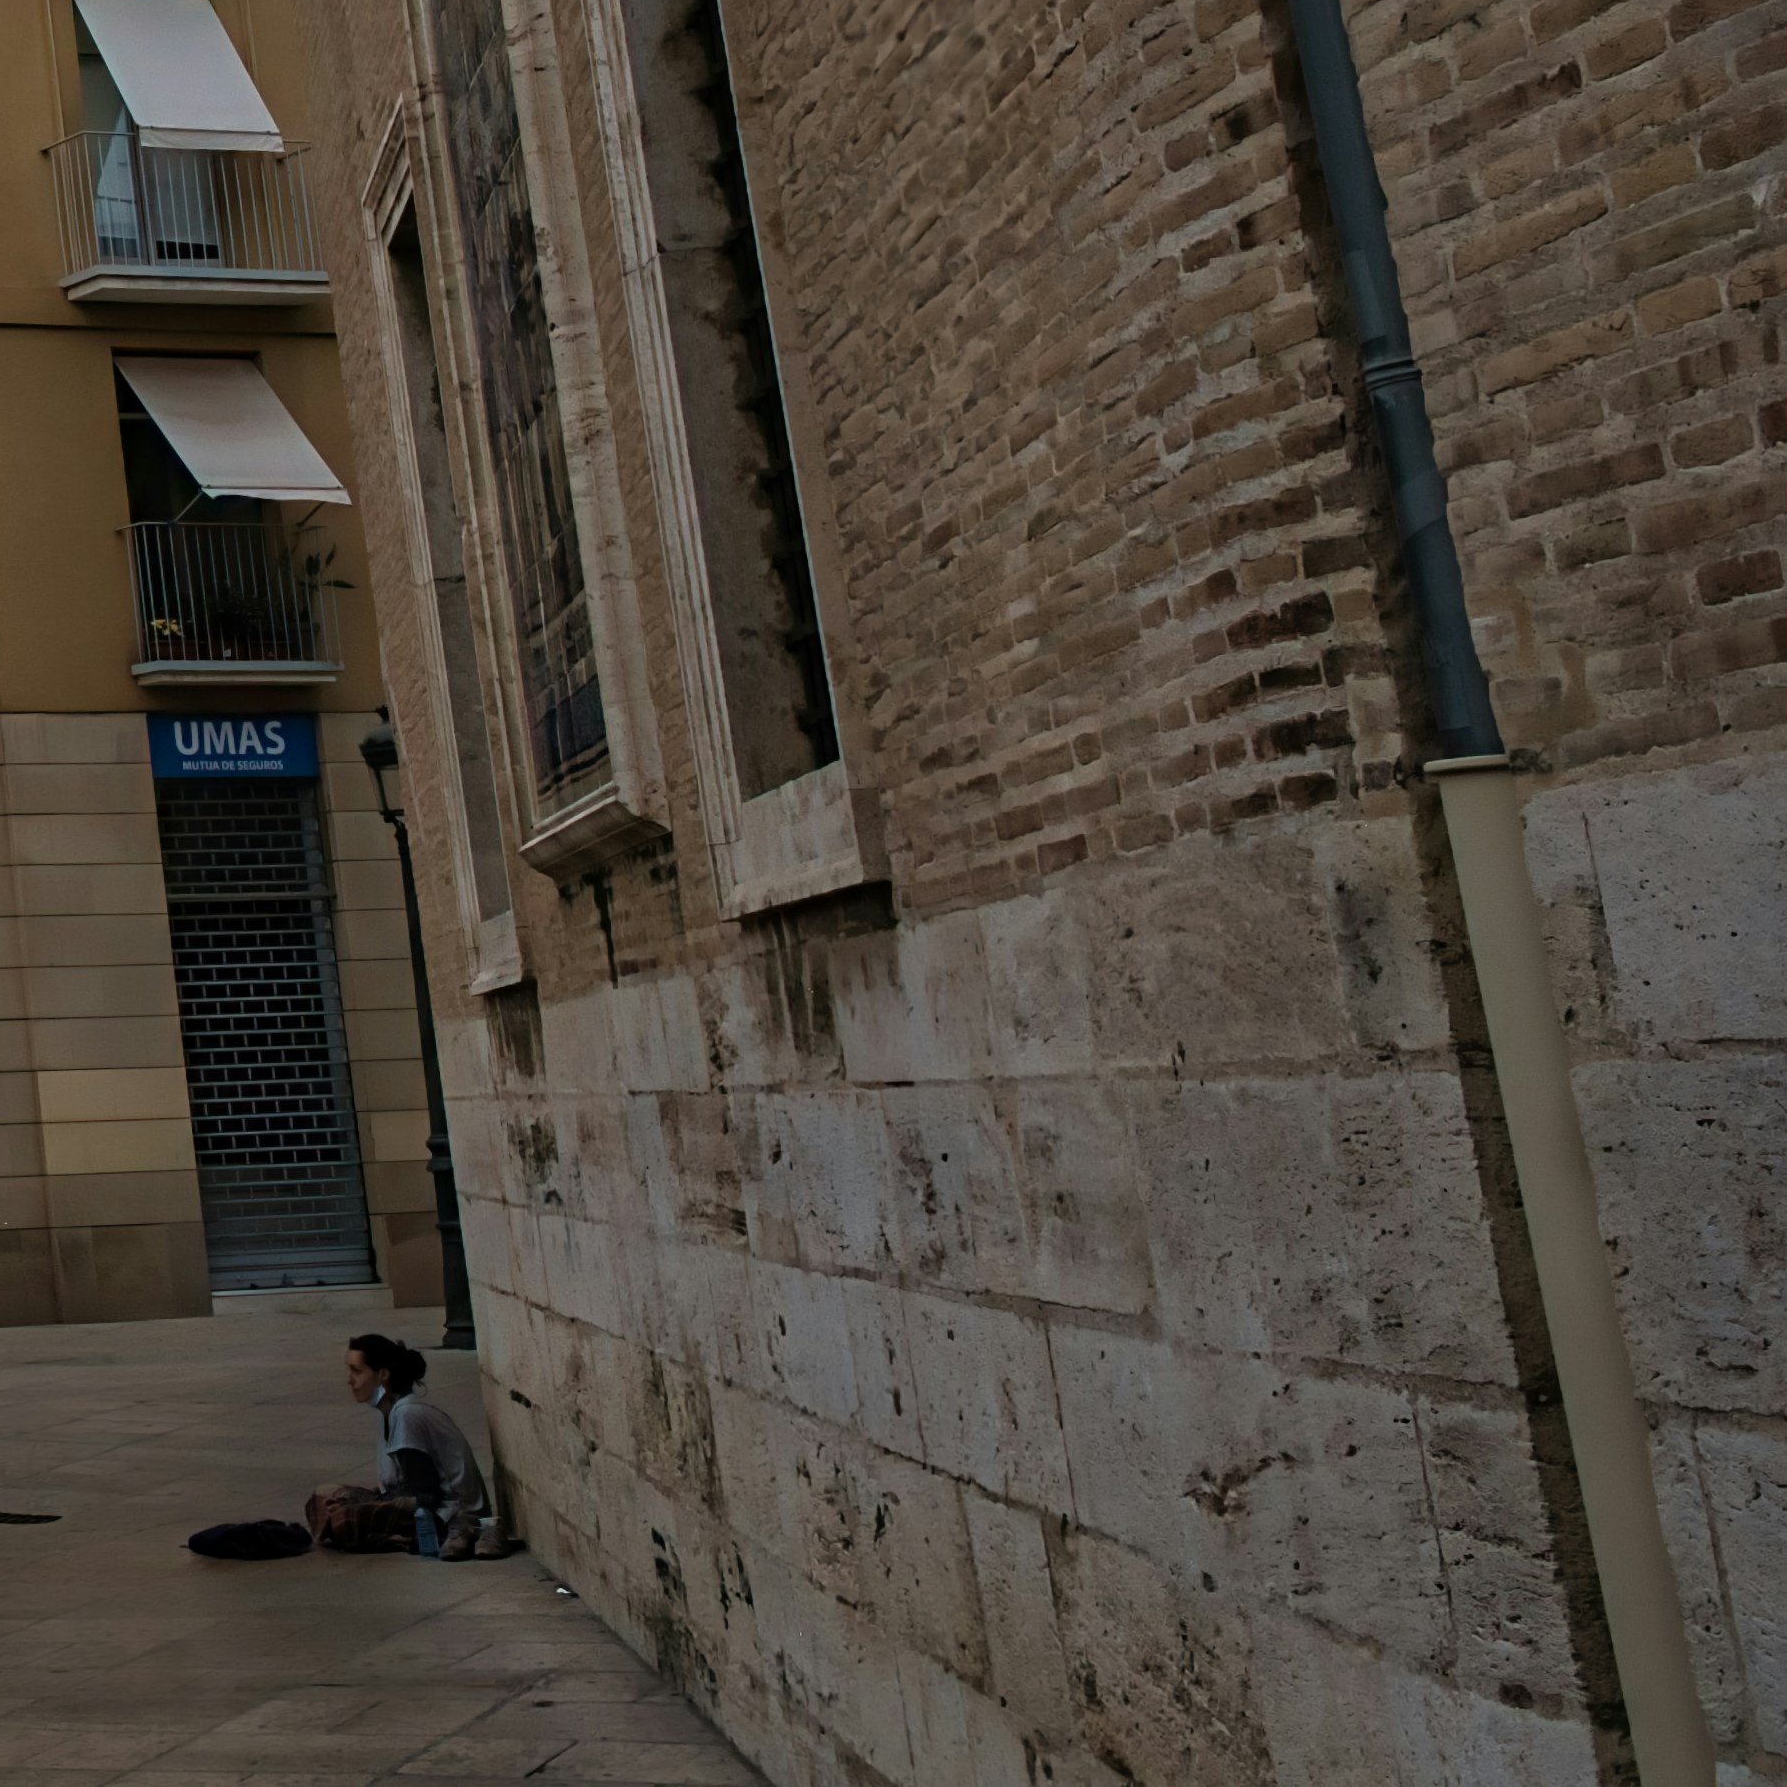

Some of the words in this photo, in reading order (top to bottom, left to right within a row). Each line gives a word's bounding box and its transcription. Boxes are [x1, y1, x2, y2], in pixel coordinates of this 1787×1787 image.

[173, 720, 286, 756] UMAS
[182, 760, 221, 771] MUTUA
[221, 760, 236, 770] DE
[237, 760, 284, 770] SEGUROS
